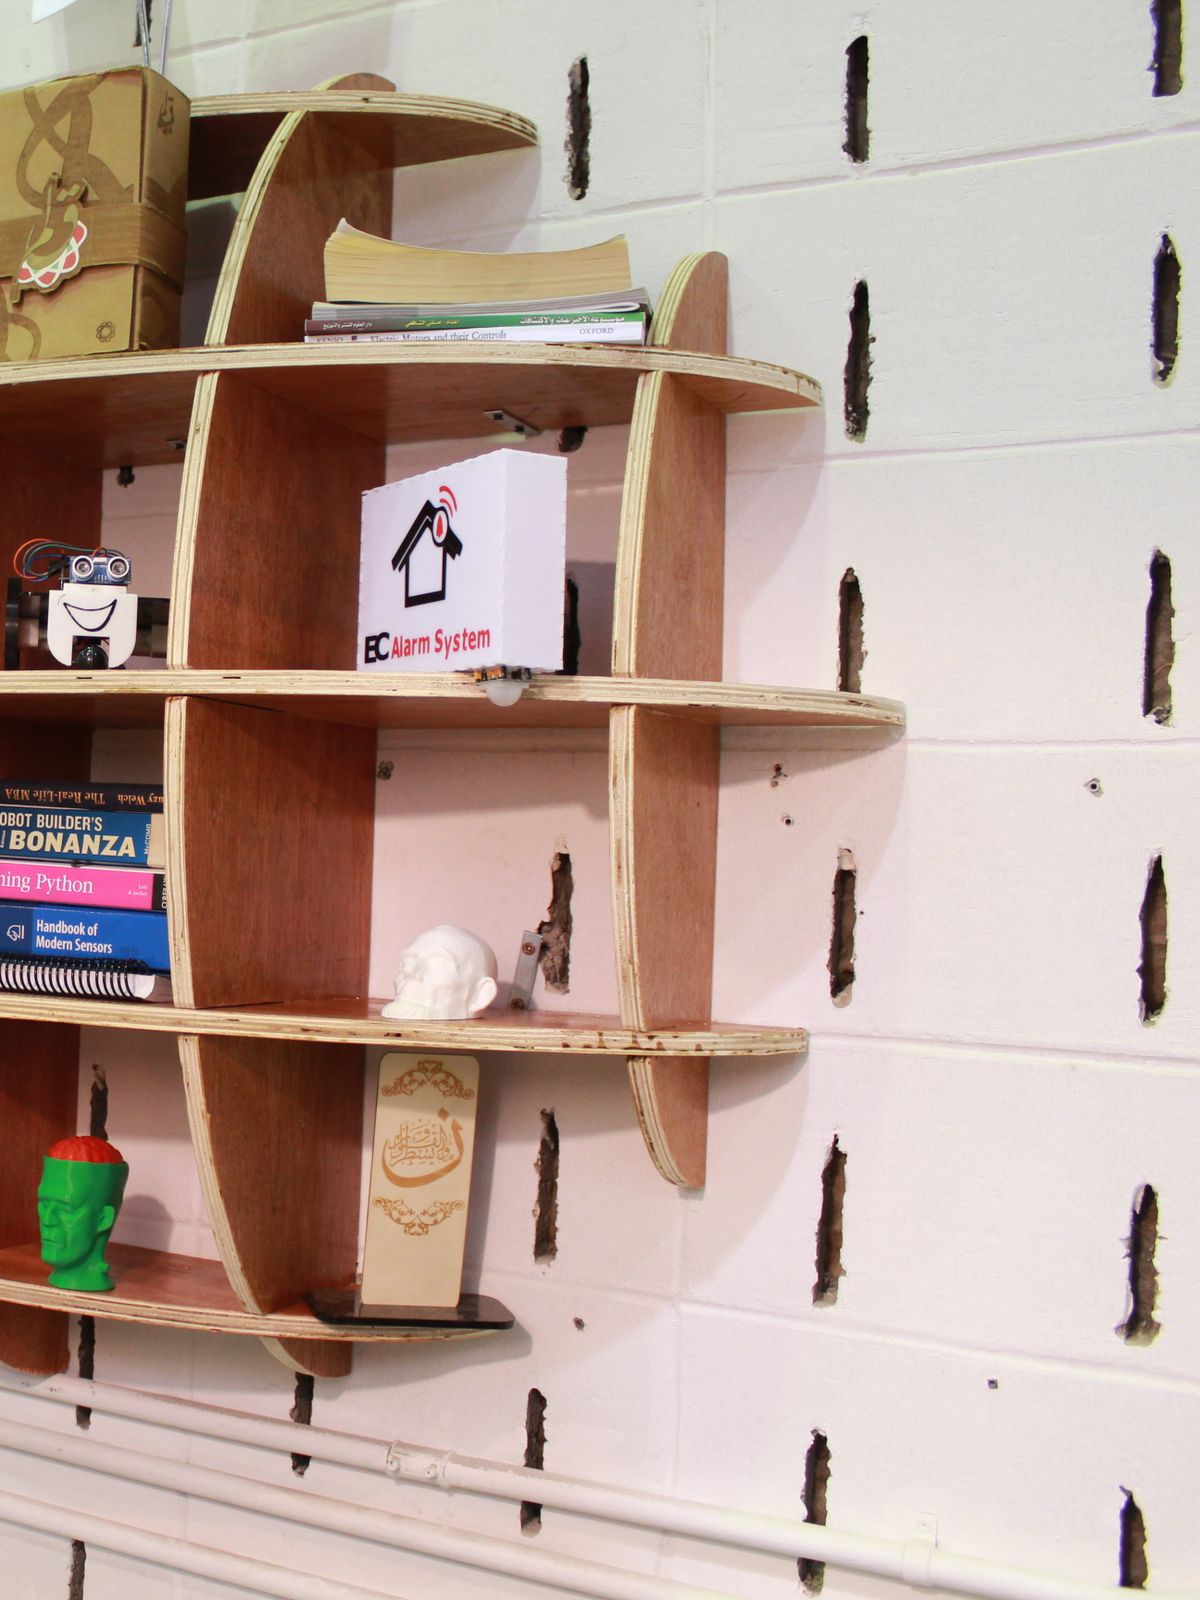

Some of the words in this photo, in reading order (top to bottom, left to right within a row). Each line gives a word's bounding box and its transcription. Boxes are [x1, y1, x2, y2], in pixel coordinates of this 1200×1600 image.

[402, 334, 431, 342] Motors
[433, 333, 449, 341] and
[450, 332, 469, 341] their
[471, 331, 507, 340] Controls
[579, 327, 614, 335] OXFORD
[364, 631, 390, 664] EC
[391, 633, 430, 659] Alarm
[434, 626, 491, 660] System
[4, 787, 30, 801] MBA
[32, 789, 82, 804] Real-Life
[84, 792, 105, 805] The
[117, 793, 146, 806] Welch
[148, 793, 164, 803] uzy
[36, 814, 103, 832] BUILDER'S
[8, 830, 137, 858] BONANZA
[36, 873, 94, 895] Python
[36, 919, 86, 935] Handbook
[86, 922, 98, 936] of
[36, 936, 74, 951] Modern
[75, 939, 113, 954] Sensors
